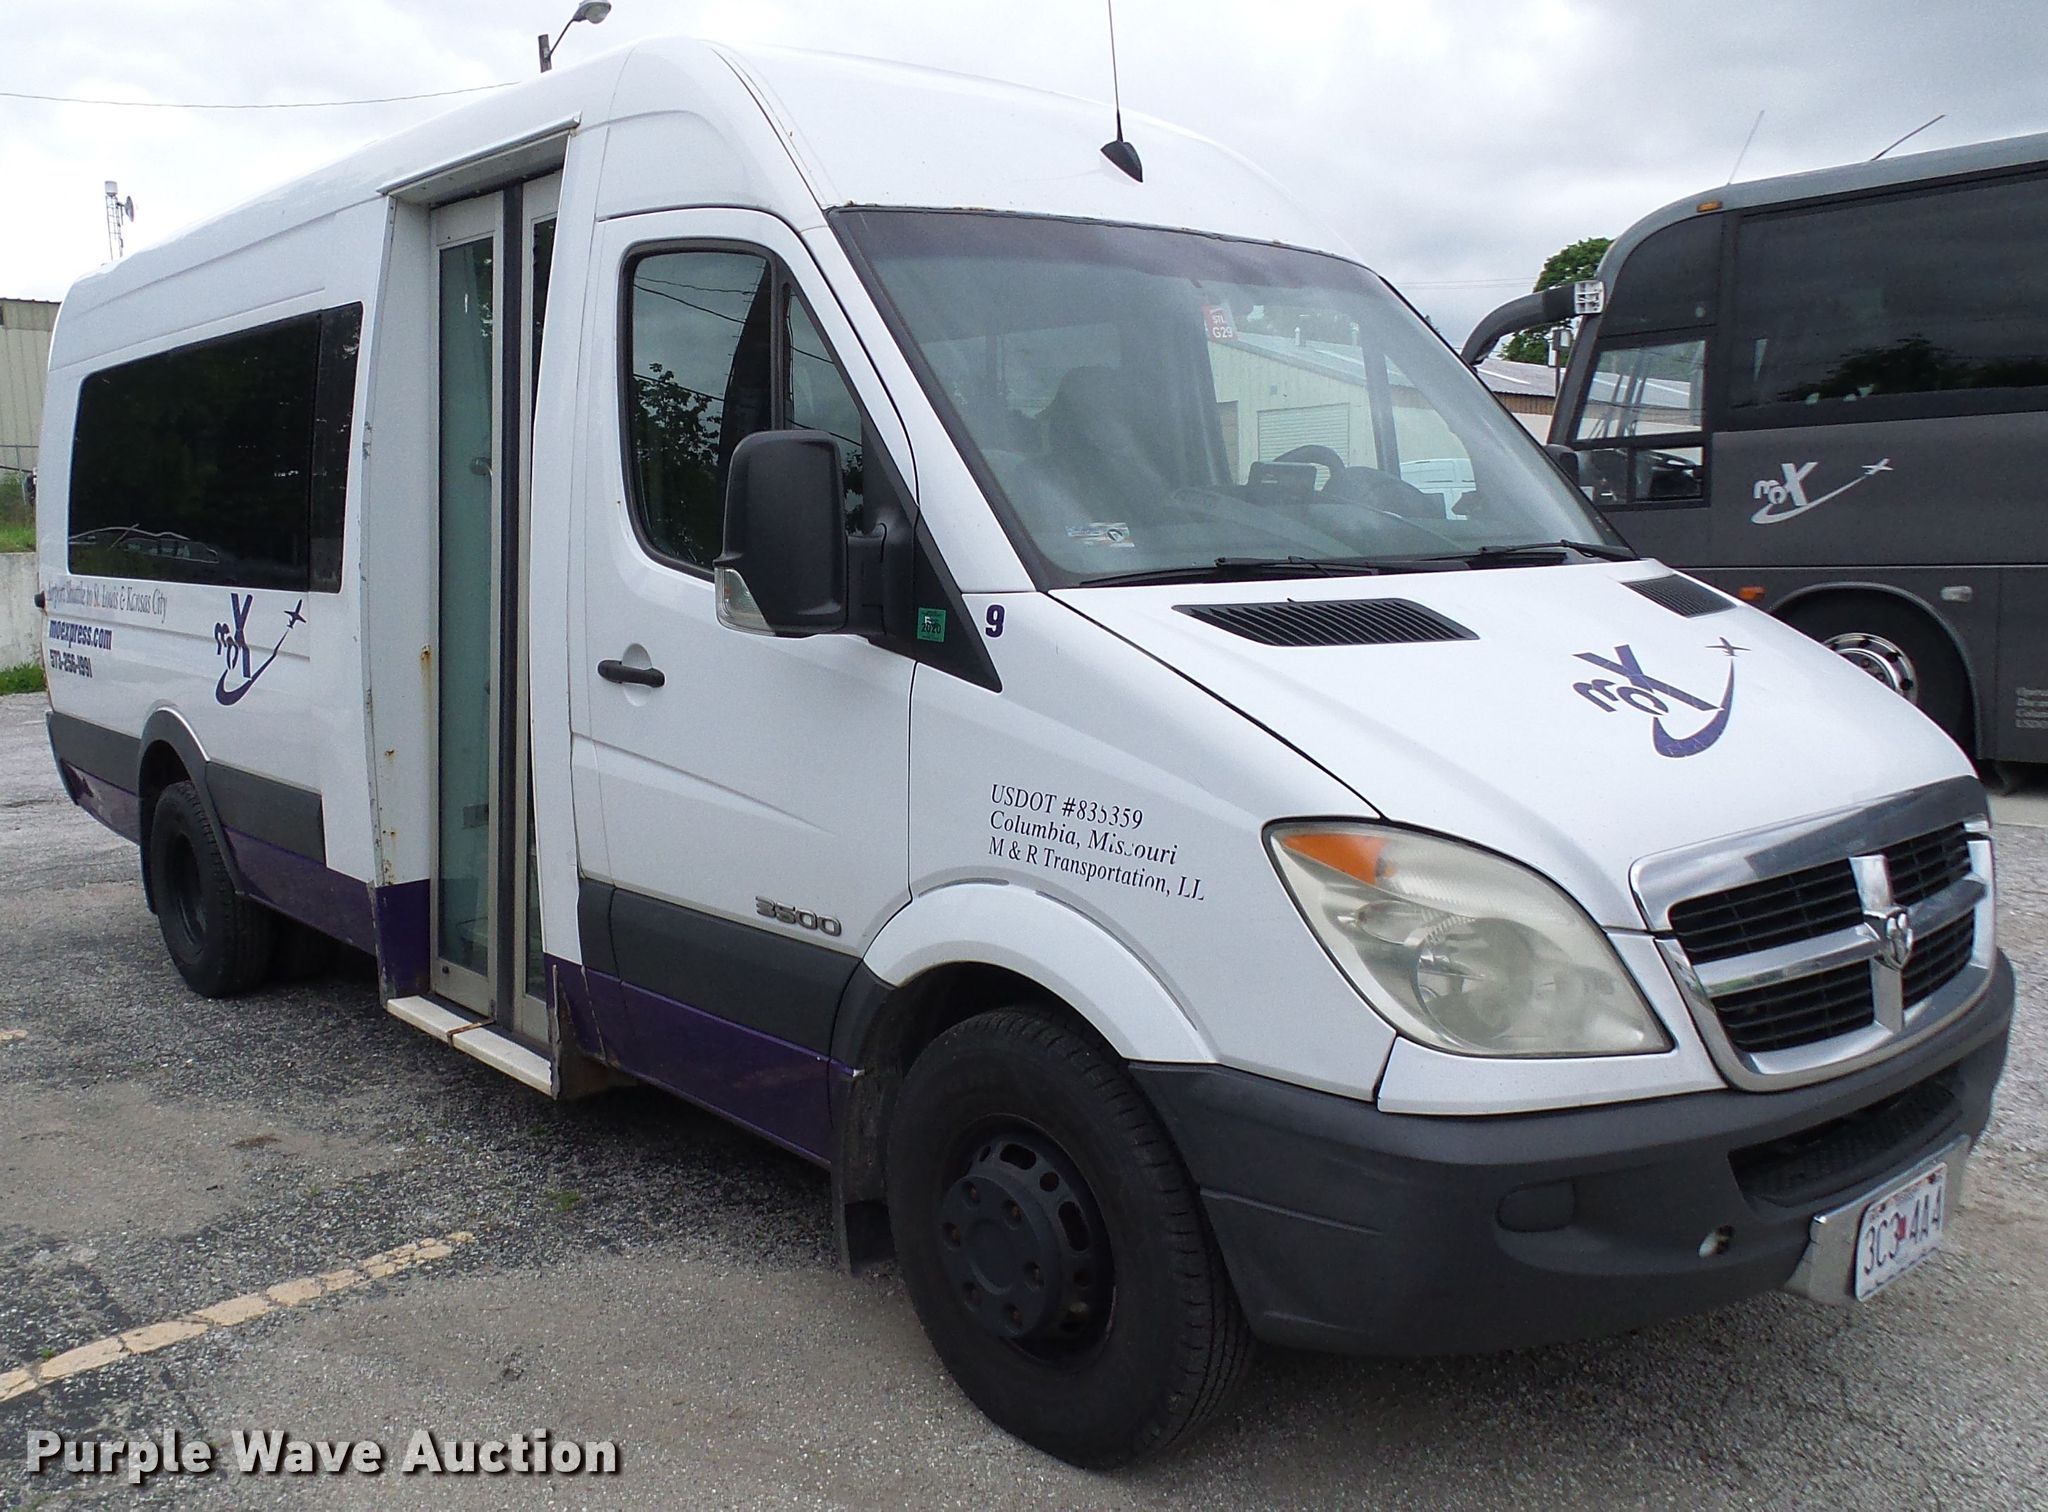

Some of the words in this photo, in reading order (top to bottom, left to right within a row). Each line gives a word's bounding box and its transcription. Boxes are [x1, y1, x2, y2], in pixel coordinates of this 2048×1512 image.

[1212, 326, 1233, 338] G29
[126, 586, 152, 614] Kansas
[152, 587, 168, 624] City
[985, 604, 1005, 638] 9
[50, 620, 112, 650] moexpress.com
[991, 784, 1057, 814] USDOT
[990, 810, 1080, 849] Columbia,
[988, 835, 1005, 857] M
[1008, 840, 1021, 861] &
[1026, 843, 1038, 865] R
[1043, 847, 1171, 897] Transportation,
[754, 895, 842, 937] 3500
